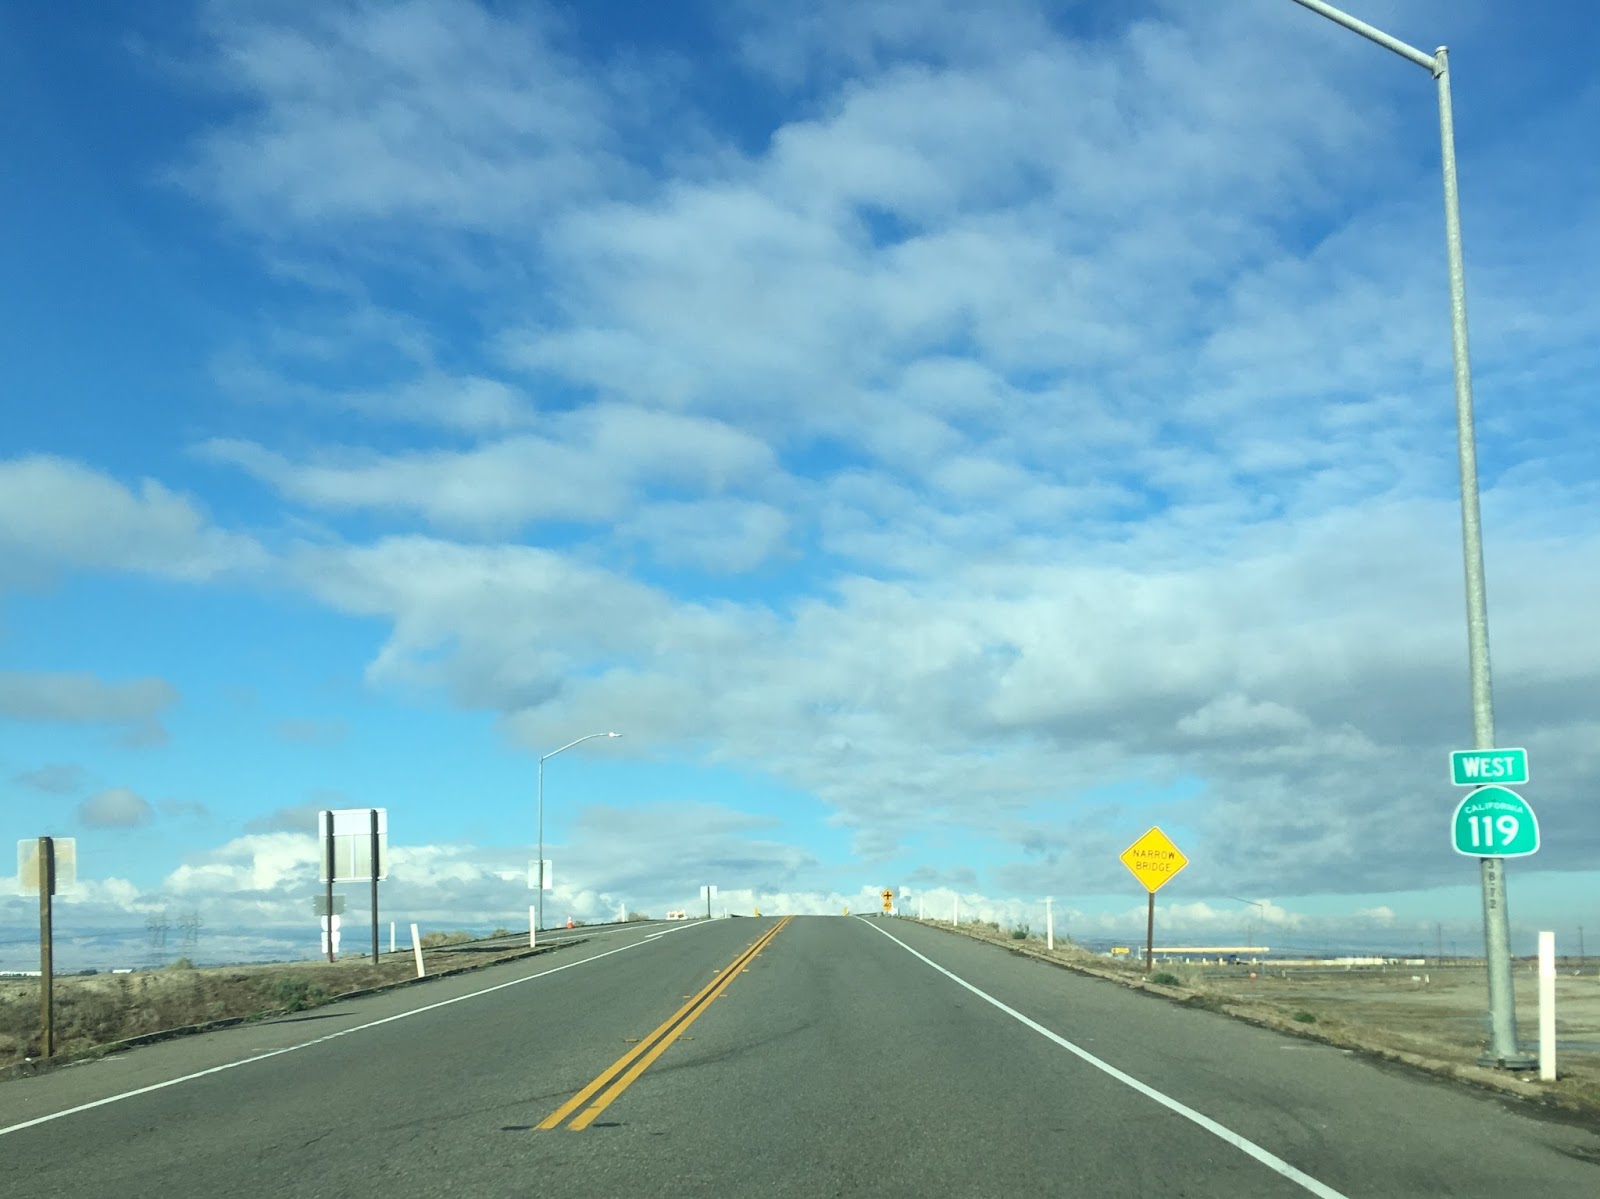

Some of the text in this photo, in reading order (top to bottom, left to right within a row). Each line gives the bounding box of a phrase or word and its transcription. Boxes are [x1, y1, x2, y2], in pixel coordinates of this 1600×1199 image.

[1462, 757, 1515, 777] WEST
[1464, 802, 1524, 814] CALIFORNIA
[1468, 815, 1519, 847] 119
[1133, 849, 1175, 860] NARROW
[1136, 861, 1171, 872] BRIDGE
